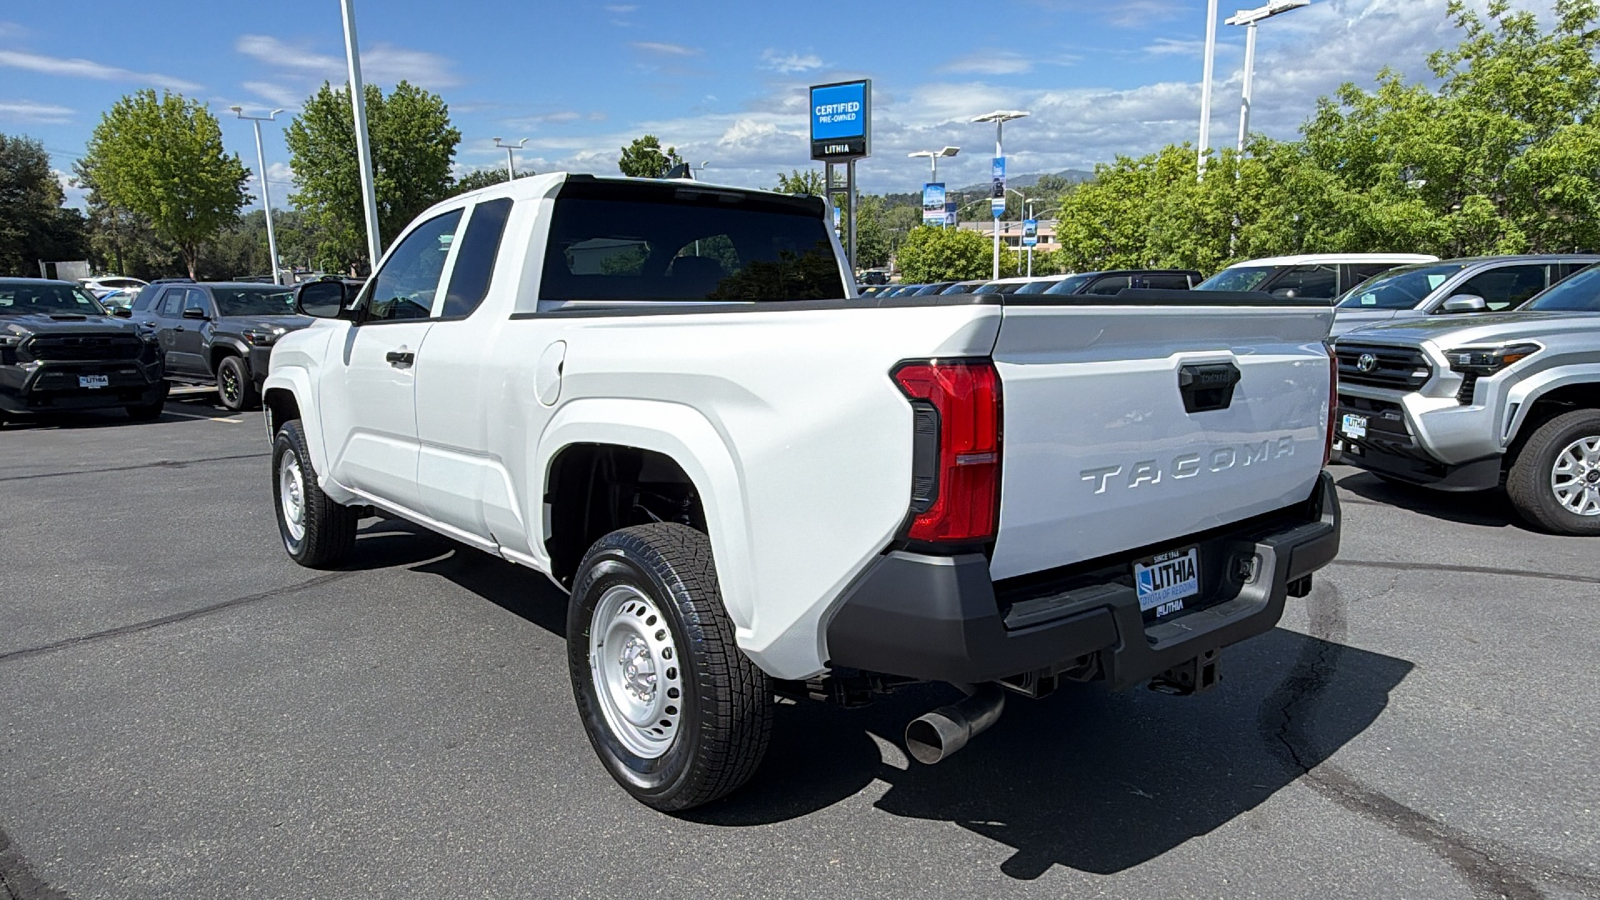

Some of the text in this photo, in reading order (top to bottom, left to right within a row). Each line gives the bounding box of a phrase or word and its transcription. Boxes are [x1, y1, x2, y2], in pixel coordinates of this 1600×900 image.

[815, 101, 860, 115] CERTIFIED
[819, 113, 856, 123] PRE-OWNED
[824, 144, 849, 154] LITHIA
[1079, 435, 1295, 495] TACOMA
[1154, 550, 1180, 563] SINCE 1946
[1151, 557, 1195, 591] LITHIA
[1139, 580, 1197, 606] TOYOTA OF REDDING
[1162, 599, 1184, 615] LITHIA
